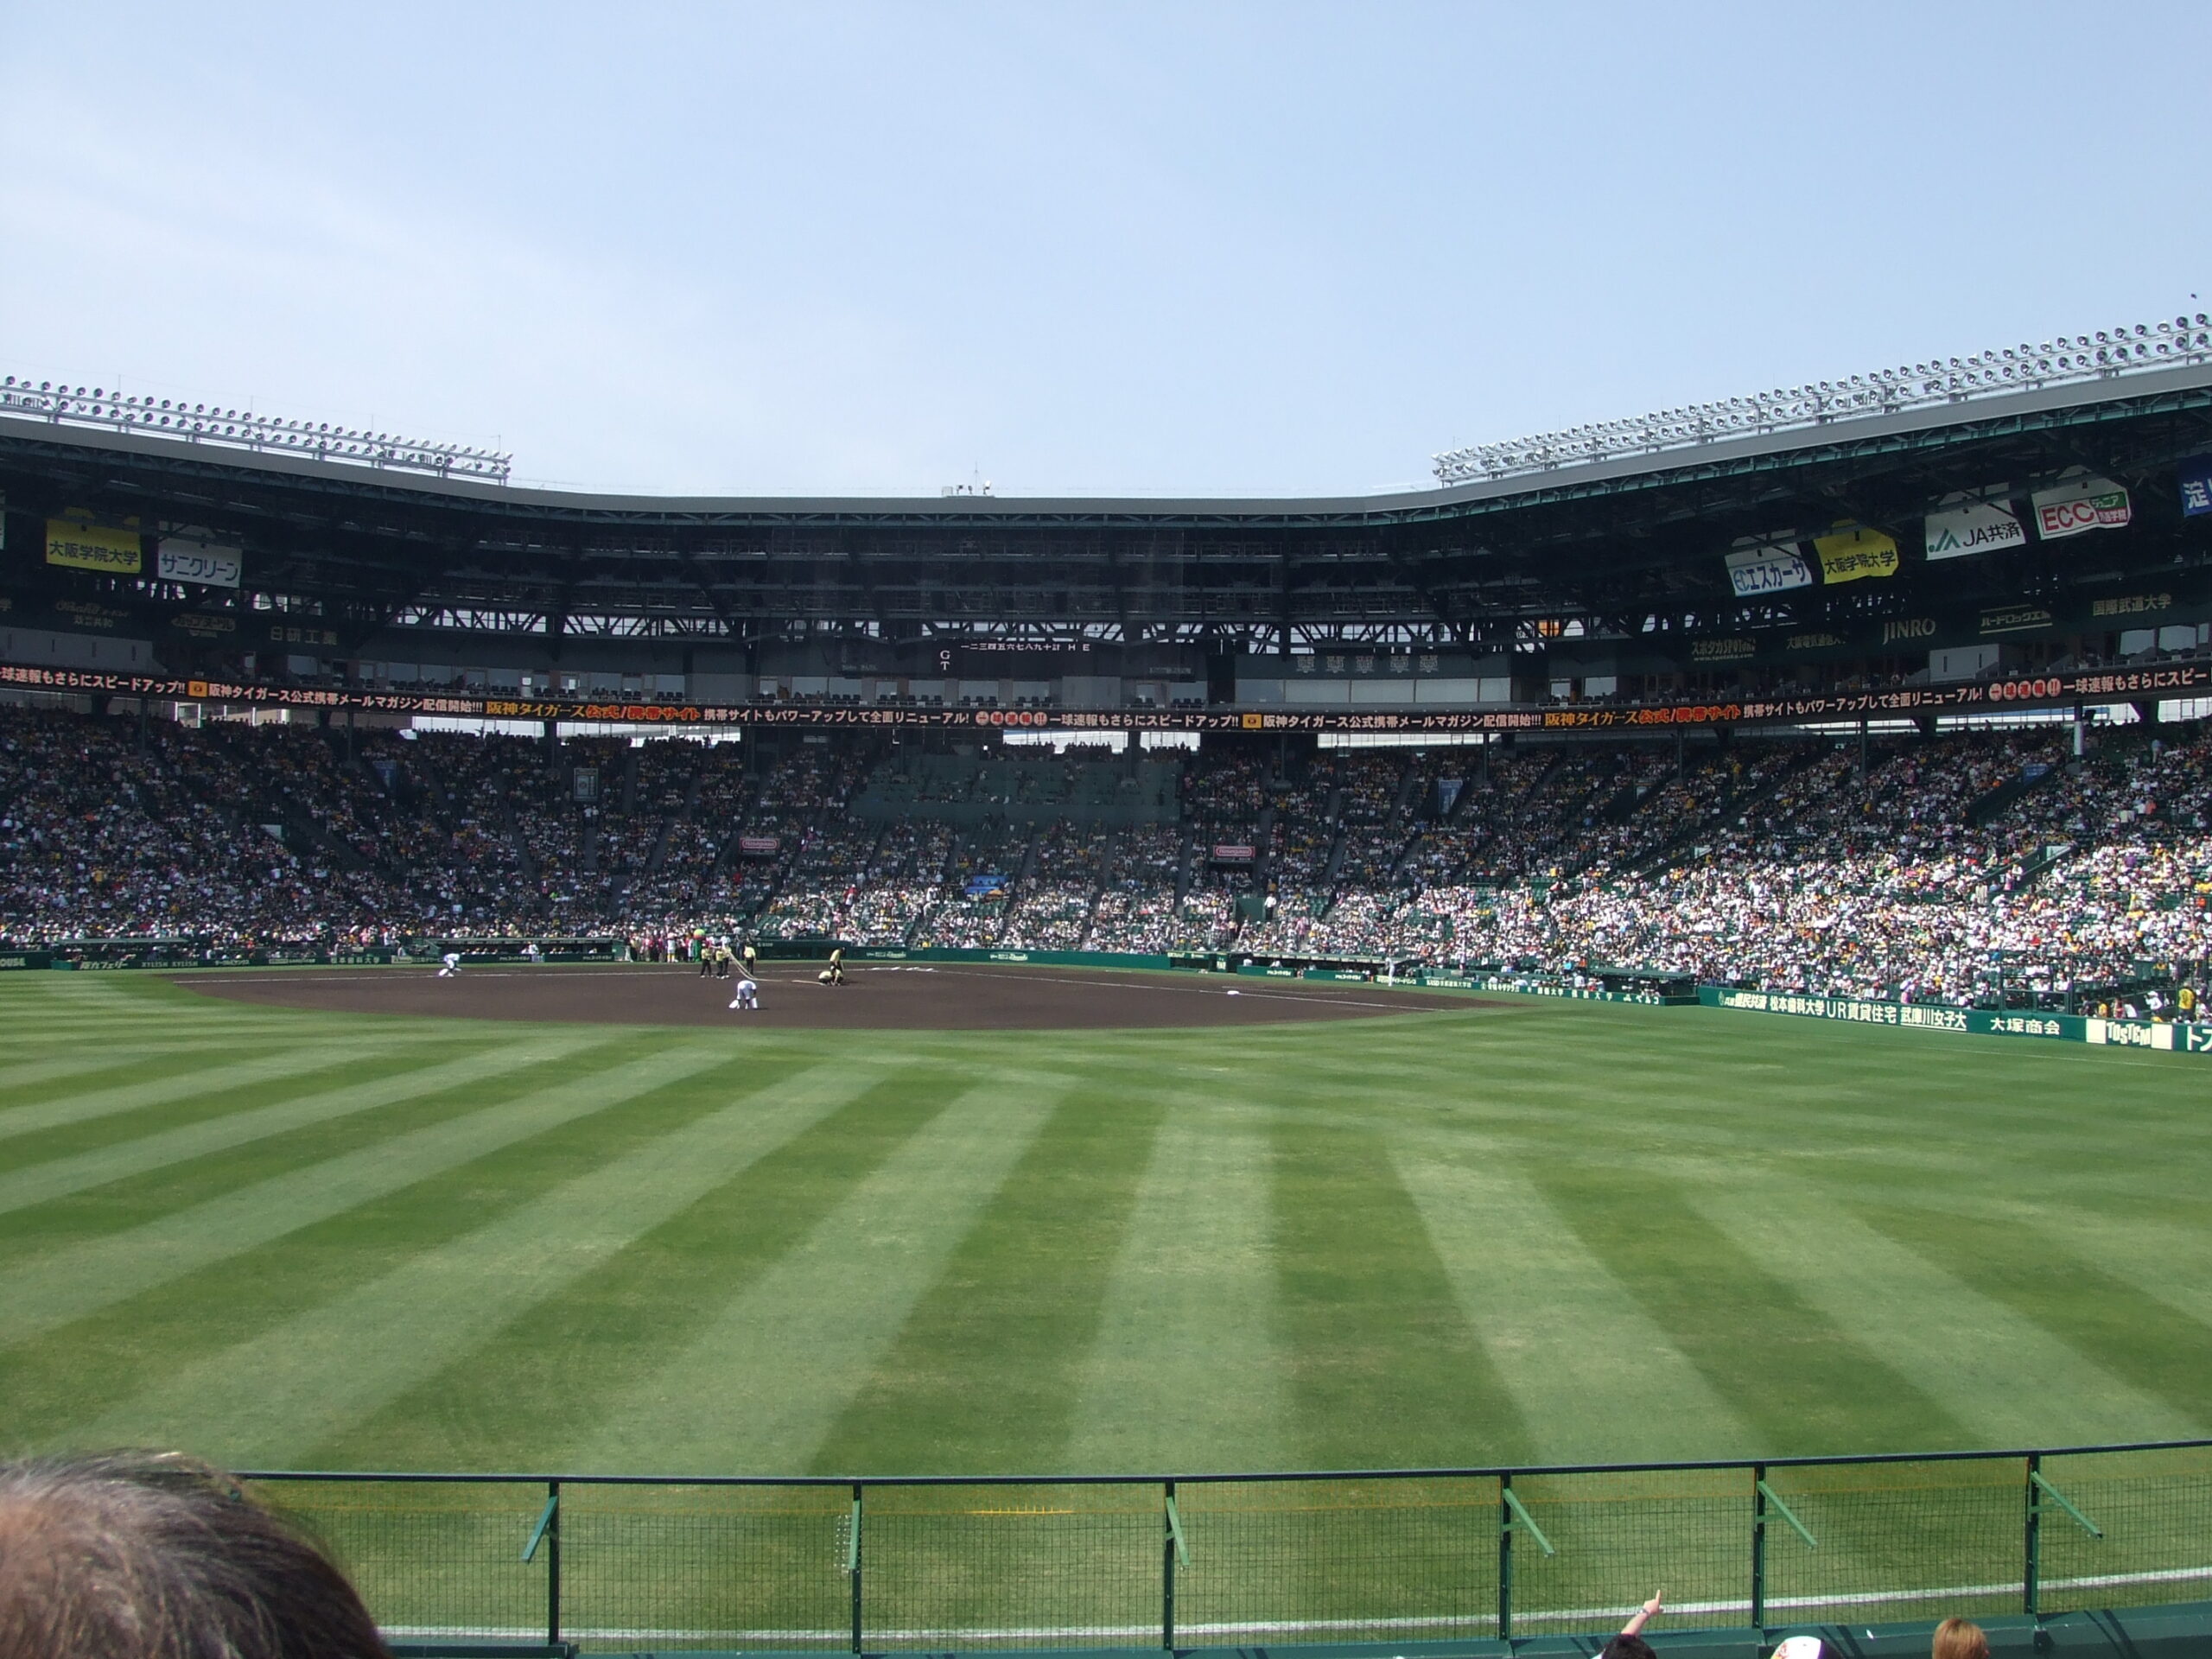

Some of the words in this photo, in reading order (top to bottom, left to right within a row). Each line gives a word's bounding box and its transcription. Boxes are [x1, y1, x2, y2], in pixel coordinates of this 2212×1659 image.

[2042, 503, 2094, 531] ECC
[1963, 522, 2020, 546] JA共済
[49, 541, 138, 565] 大阪学院大学
[1825, 550, 1896, 574] 大阪学院大学
[162, 554, 238, 581] サニクリーン
[1746, 559, 1804, 590] エスカーサ
[1882, 619, 1936, 645] JINRO
[0, 667, 185, 693] 球速報もさらにスピードアップ!!
[2063, 668, 2212, 695] 一球速報もさらにスピー
[1770, 995, 1824, 1016] 松本歯科大学
[1899, 1006, 1967, 1028] 武庫川女子大
[1990, 1017, 2060, 1035] 大塚商会
[2107, 1021, 2151, 1046] TOSTEM
